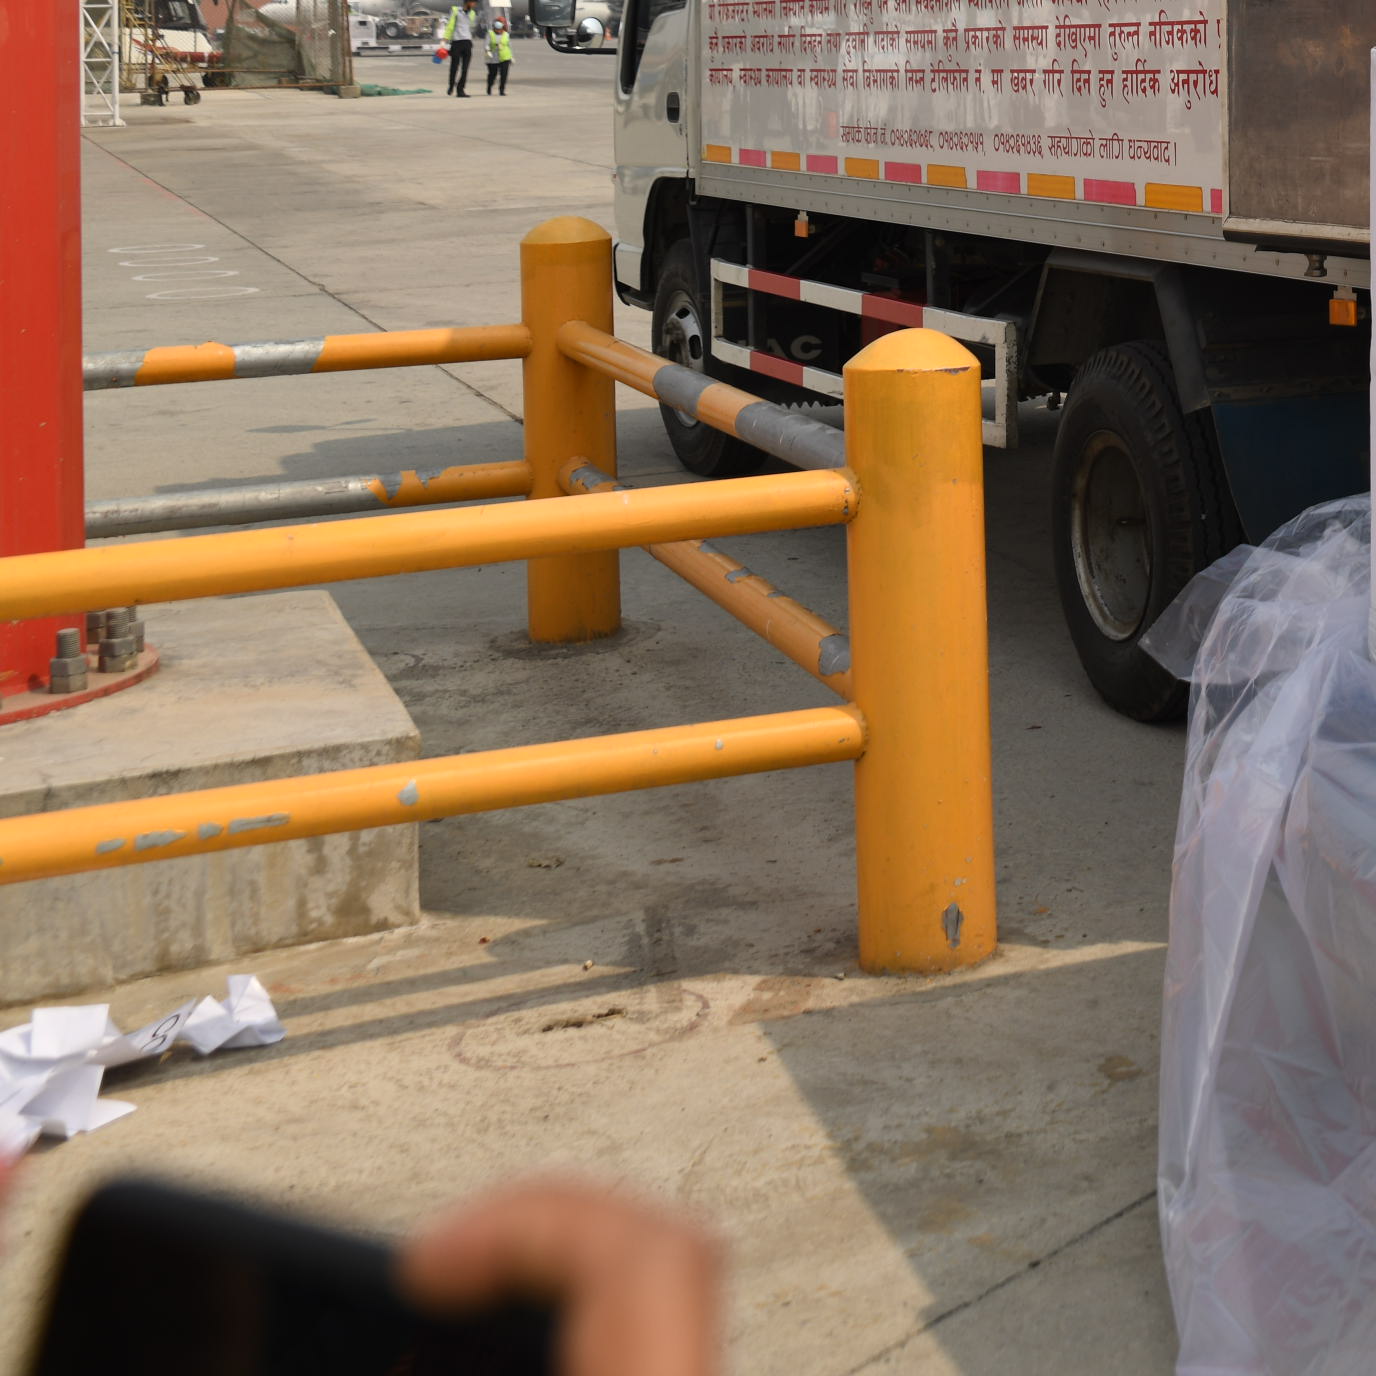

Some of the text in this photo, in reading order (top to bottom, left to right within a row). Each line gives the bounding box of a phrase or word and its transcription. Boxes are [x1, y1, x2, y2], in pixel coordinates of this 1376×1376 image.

[826, 32, 841, 56] तथा
[905, 29, 937, 53] समयमा
[943, 18, 959, 63] कुनै
[964, 20, 1007, 53] प्रकारको
[1013, 25, 1049, 50] समस्या
[1055, 14, 1102, 58] देखिएमा
[1109, 22, 1141, 61] तुरुन्त
[1149, 9, 1208, 50] नजिकको
[797, 68, 806, 89] वा
[843, 63, 858, 90] सेवा
[863, 60, 900, 91] विभागको
[905, 60, 925, 92] निम्न
[930, 60, 969, 94] टेलिफोन
[991, 68, 1004, 94] मा
[1010, 68, 1036, 96] खबर
[1042, 59, 1064, 97] गरि
[1071, 58, 1091, 97] दिन
[1099, 69, 1115, 108] हुन
[1122, 58, 1161, 104] हार्दिक
[1169, 60, 1220, 110] अनुरोध
[1047, 127, 1095, 159] सहयोगको
[1099, 132, 1124, 161] लागि
